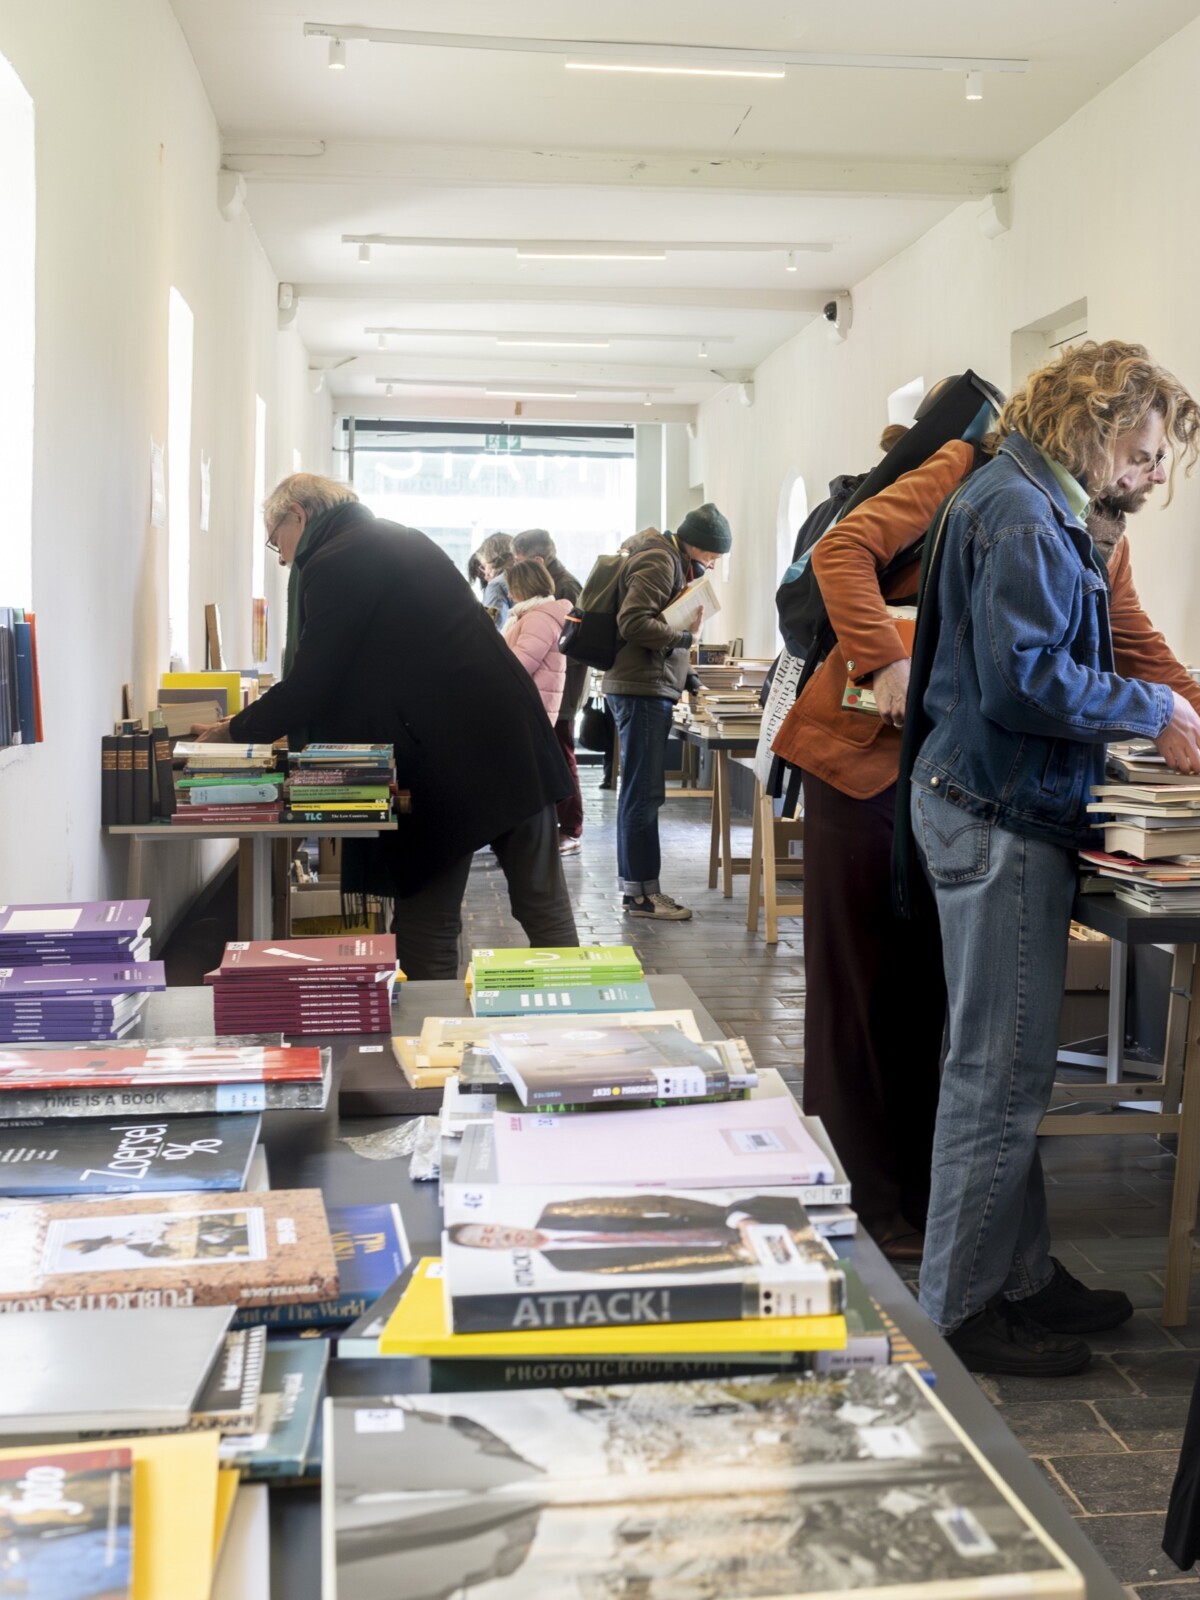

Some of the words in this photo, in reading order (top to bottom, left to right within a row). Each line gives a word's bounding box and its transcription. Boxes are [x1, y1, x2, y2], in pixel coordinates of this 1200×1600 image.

[766, 680, 796, 742] Guislain
[304, 812, 322, 821] TLC
[43, 1095, 80, 1108] TIME
[86, 1094, 100, 1107] IS
[105, 1094, 115, 1106] A
[122, 1092, 168, 1106] BOOK
[80, 1124, 168, 1182] Zoersel
[319, 1298, 367, 1318] World
[511, 1290, 671, 1328] ATTACK!
